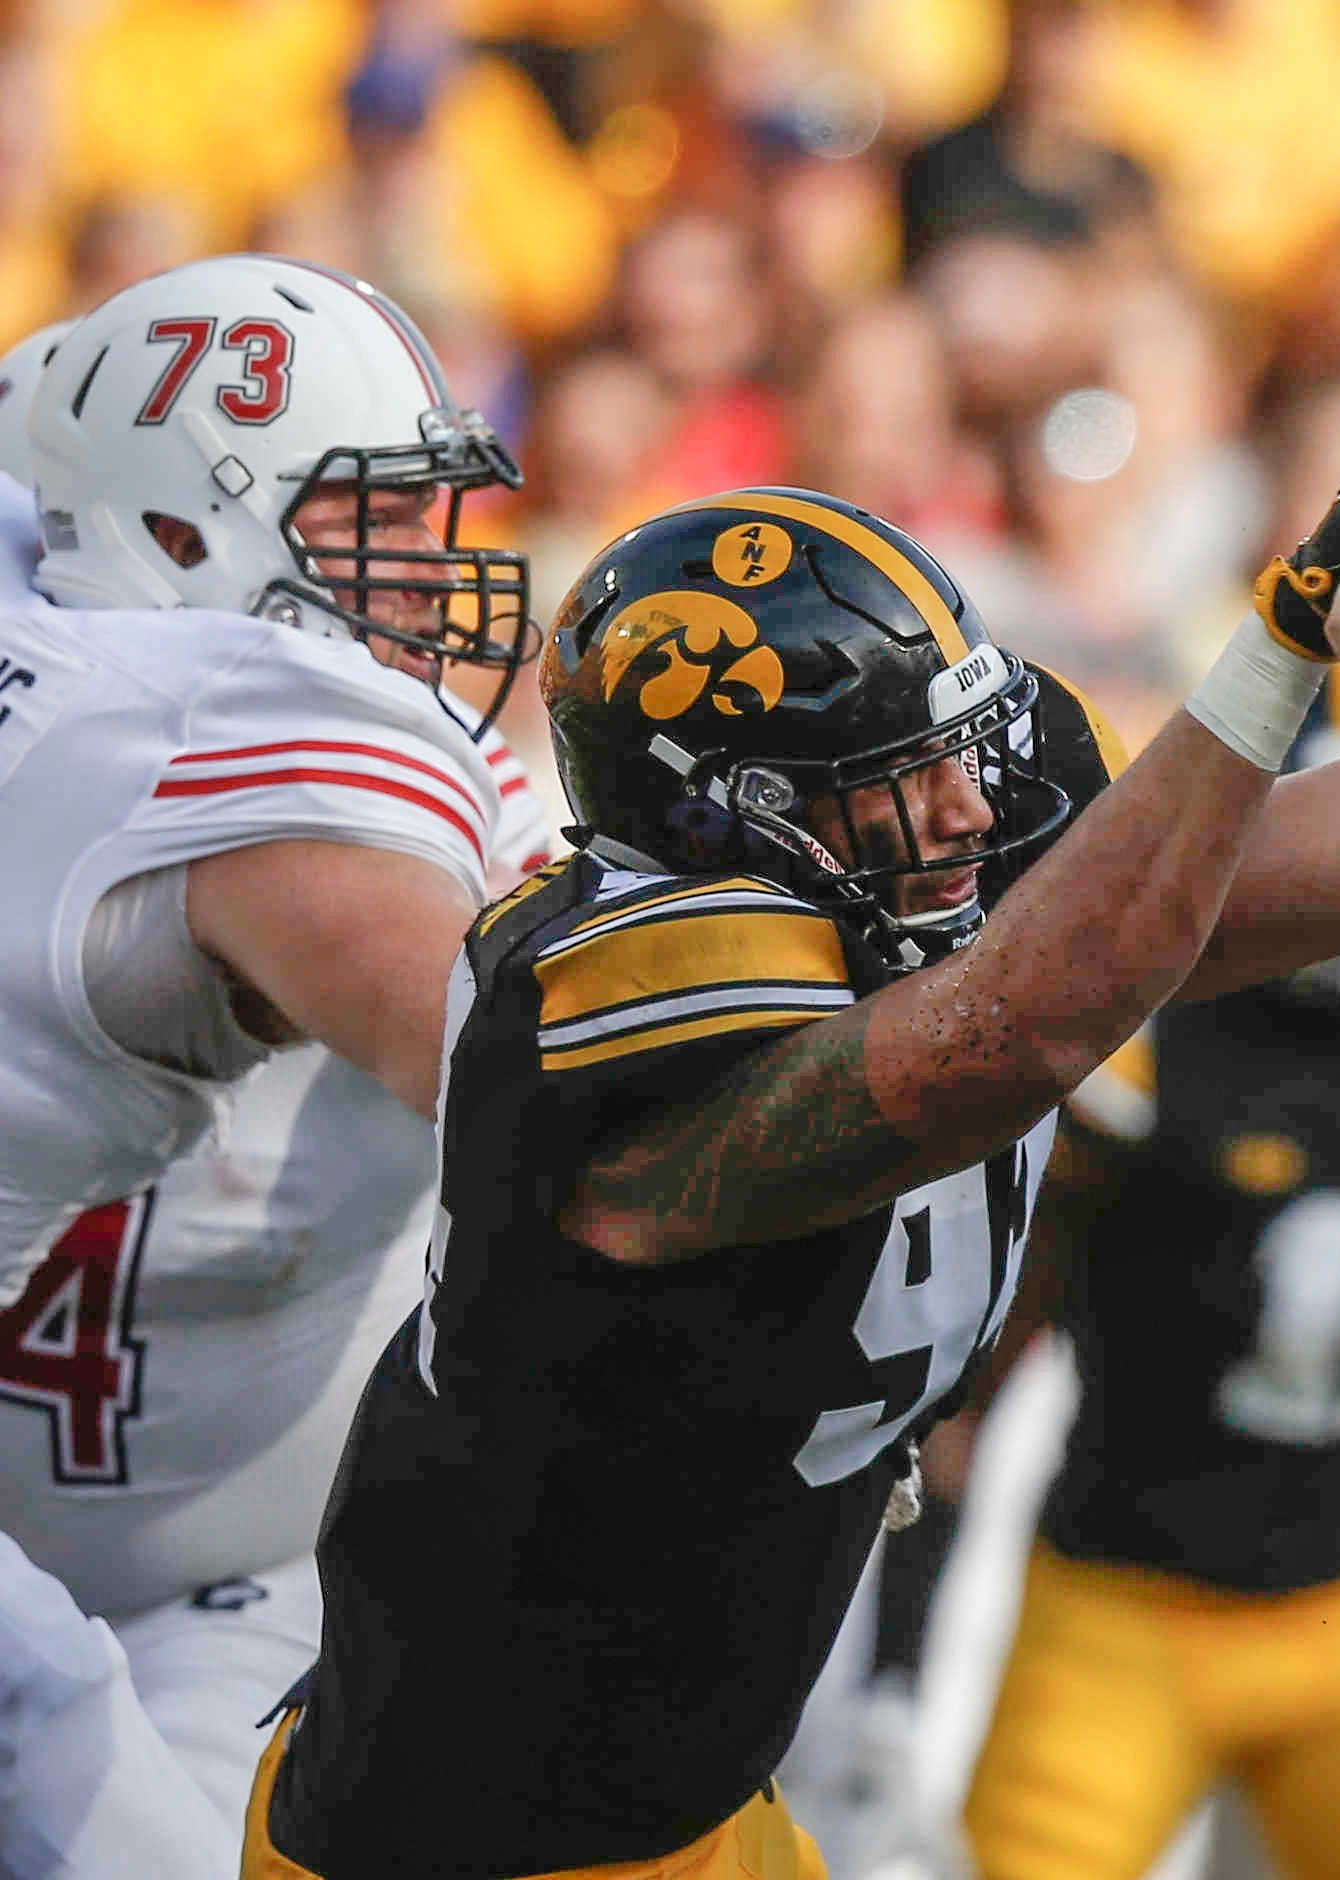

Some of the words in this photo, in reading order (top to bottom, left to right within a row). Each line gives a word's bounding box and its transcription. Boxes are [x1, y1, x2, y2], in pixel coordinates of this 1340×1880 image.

[134, 317, 295, 427] 73
[739, 525, 767, 582] ANF
[953, 655, 992, 693] IOWA
